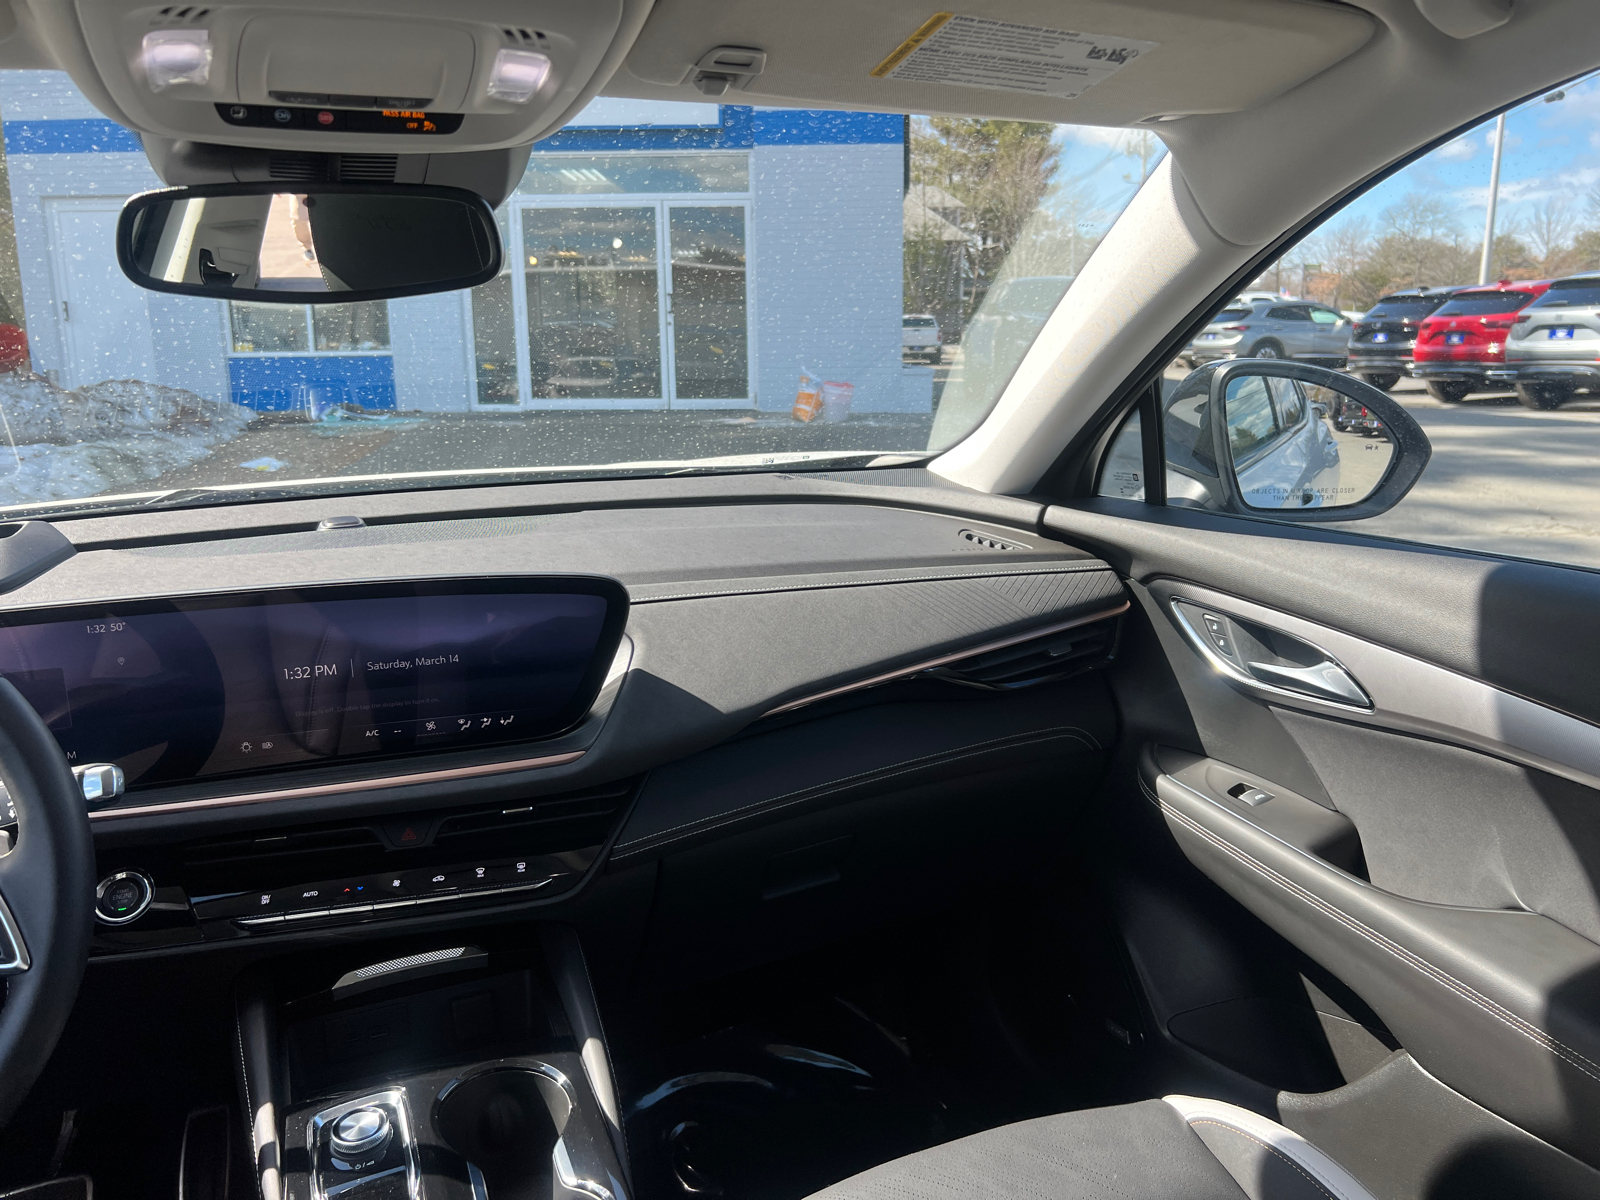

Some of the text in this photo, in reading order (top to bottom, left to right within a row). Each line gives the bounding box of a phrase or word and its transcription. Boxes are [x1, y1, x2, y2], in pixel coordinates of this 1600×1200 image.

[953, 15, 977, 23] EVEN
[999, 22, 1043, 32] ADVANCED
[400, 110, 411, 118] AIR
[412, 111, 425, 119] BAG
[1252, 487, 1280, 495] OBJECTS
[86, 621, 126, 634] 1:32 50°
[367, 654, 459, 671] Saturday, March 14
[284, 663, 338, 680] 1:32 PM
[338, 704, 359, 713] Double
[360, 704, 370, 712] tap
[382, 700, 403, 709] display
[365, 729, 380, 737] A/C
[112, 891, 133, 901] ENGINE
[302, 890, 319, 898] AUTO
